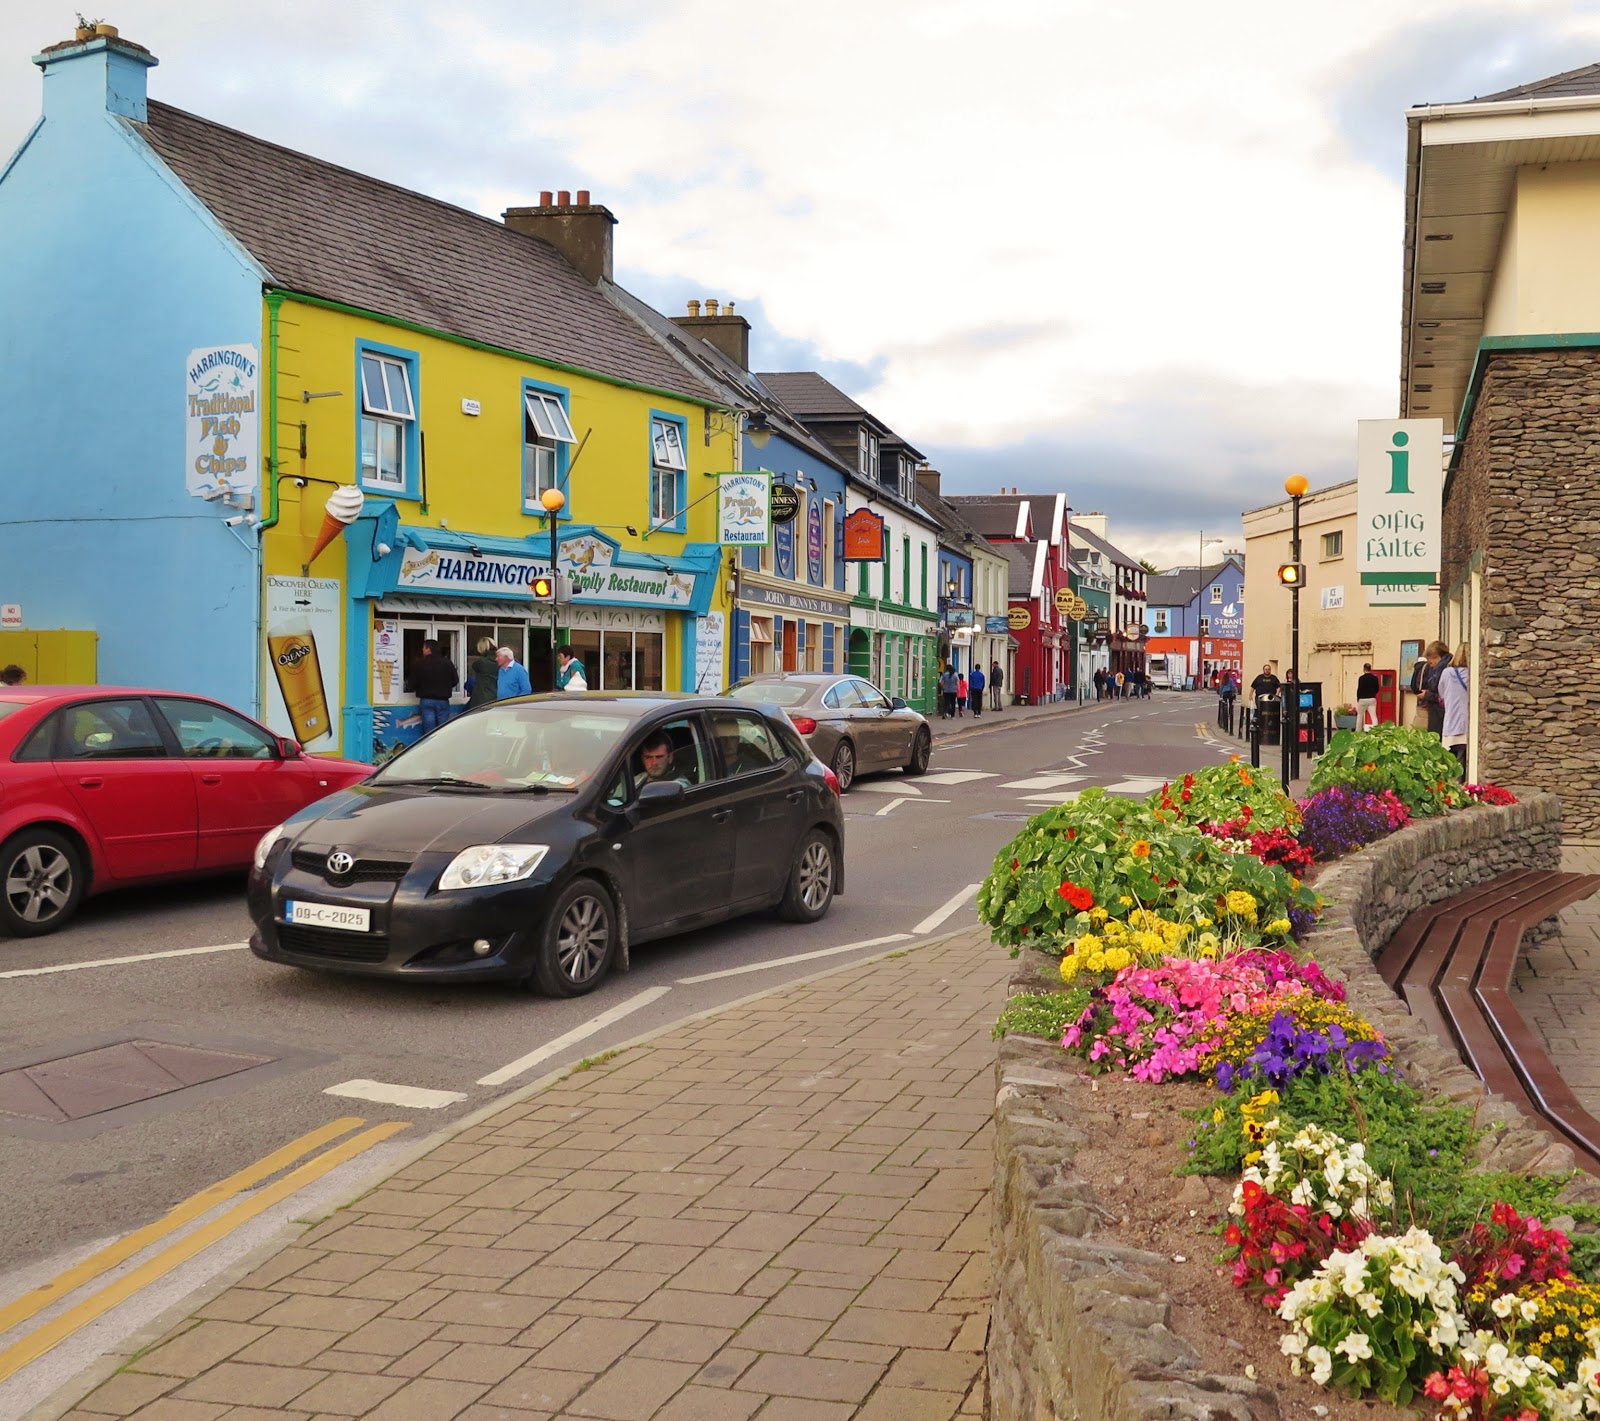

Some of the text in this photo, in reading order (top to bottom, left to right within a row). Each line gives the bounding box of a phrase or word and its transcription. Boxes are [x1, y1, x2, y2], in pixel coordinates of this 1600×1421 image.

[190, 350, 256, 382] HARRINGTON'S
[188, 390, 255, 417] Traditional
[200, 416, 241, 442] Fish
[213, 435, 228, 456] &
[195, 453, 247, 479] Chips
[722, 476, 767, 493] HARRINGTON'S
[771, 496, 797, 504] INNESS
[724, 528, 765, 542] Restaurant
[608, 573, 667, 597] Restaurant
[764, 590, 833, 613] JOHN BENNY'S PUB
[1330, 597, 1342, 606] PLANT
[1214, 618, 1245, 626] STRAND
